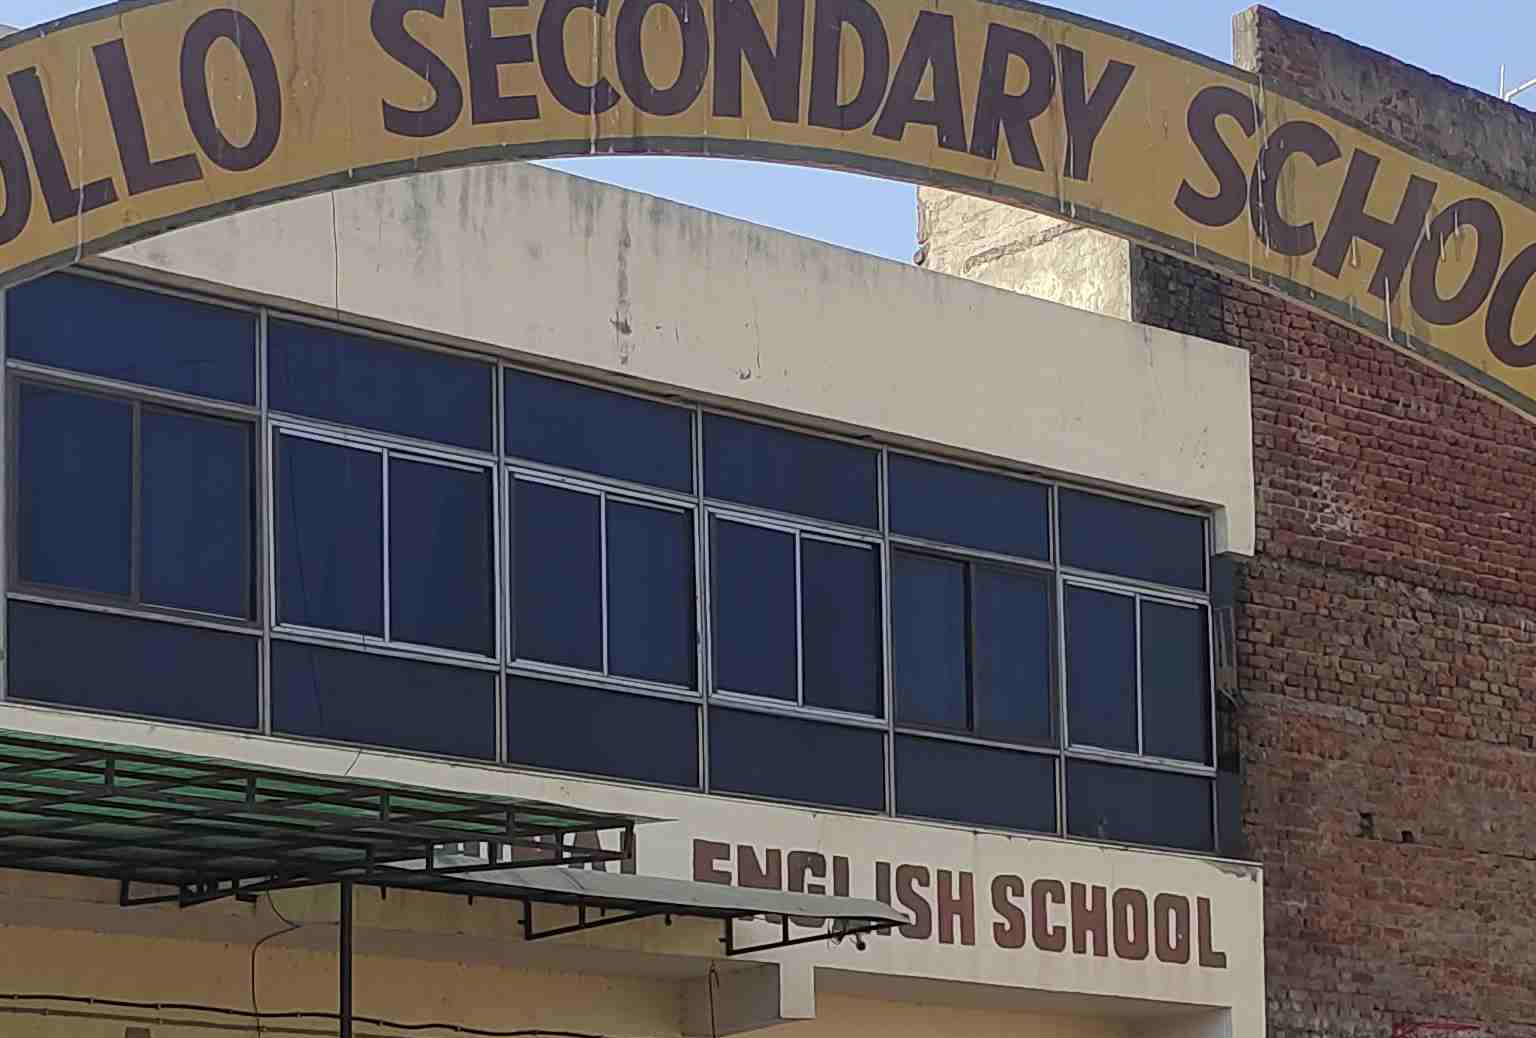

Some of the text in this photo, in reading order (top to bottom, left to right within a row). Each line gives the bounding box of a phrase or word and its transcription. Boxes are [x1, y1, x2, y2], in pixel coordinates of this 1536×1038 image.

[370, 0, 1136, 181] SECONDARY
[692, 838, 976, 945] ENGLISH
[991, 874, 1228, 969] SCHOOL
